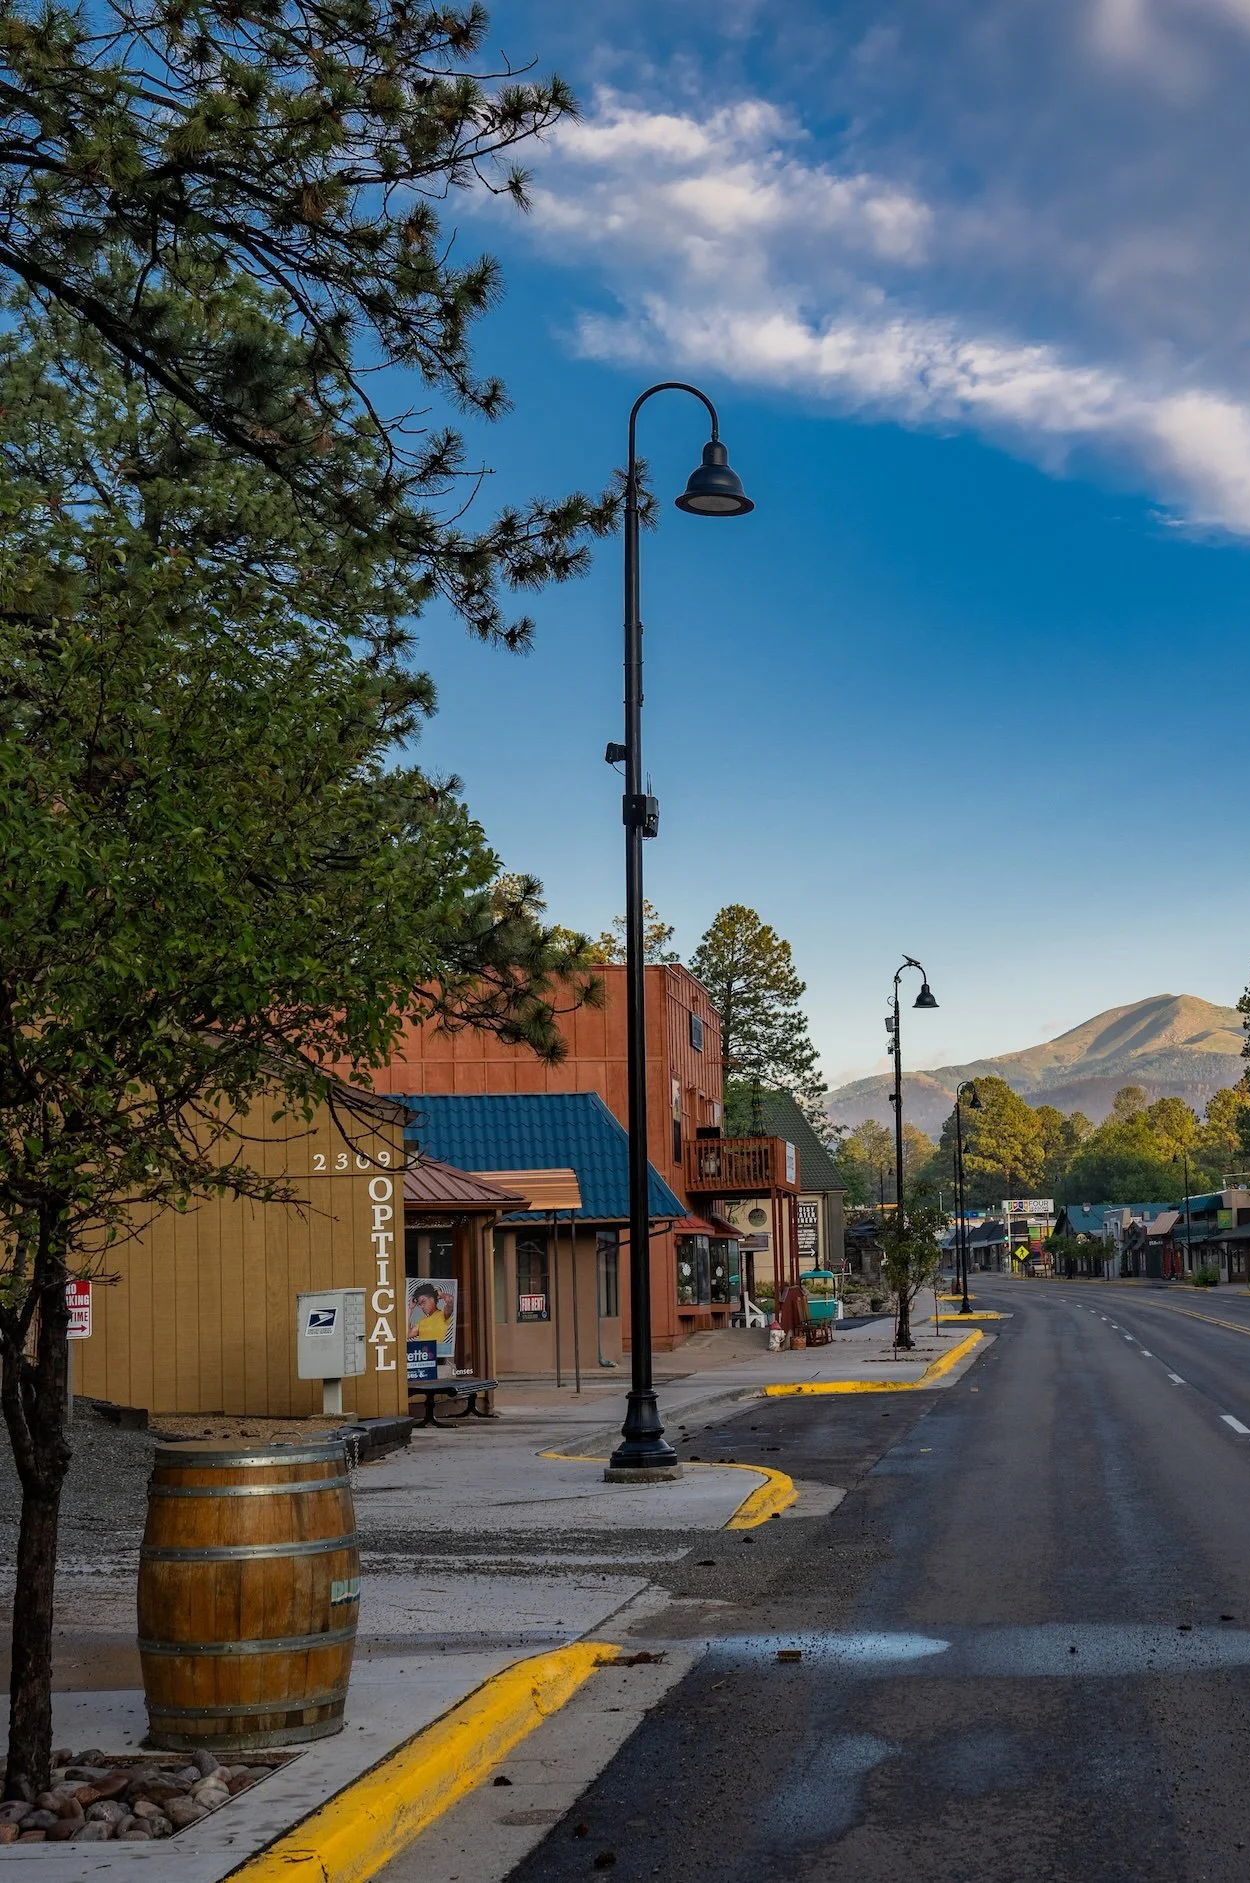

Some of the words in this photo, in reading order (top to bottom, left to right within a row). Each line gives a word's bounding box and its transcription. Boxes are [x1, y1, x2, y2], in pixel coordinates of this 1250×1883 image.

[313, 1151, 391, 1171] 2309
[368, 1176, 396, 1371] OPTICAL
[522, 1297, 530, 1311] FOR
[531, 1297, 543, 1311] RENT
[407, 1350, 428, 1361] ette
[452, 1368, 474, 1376] Lenses
